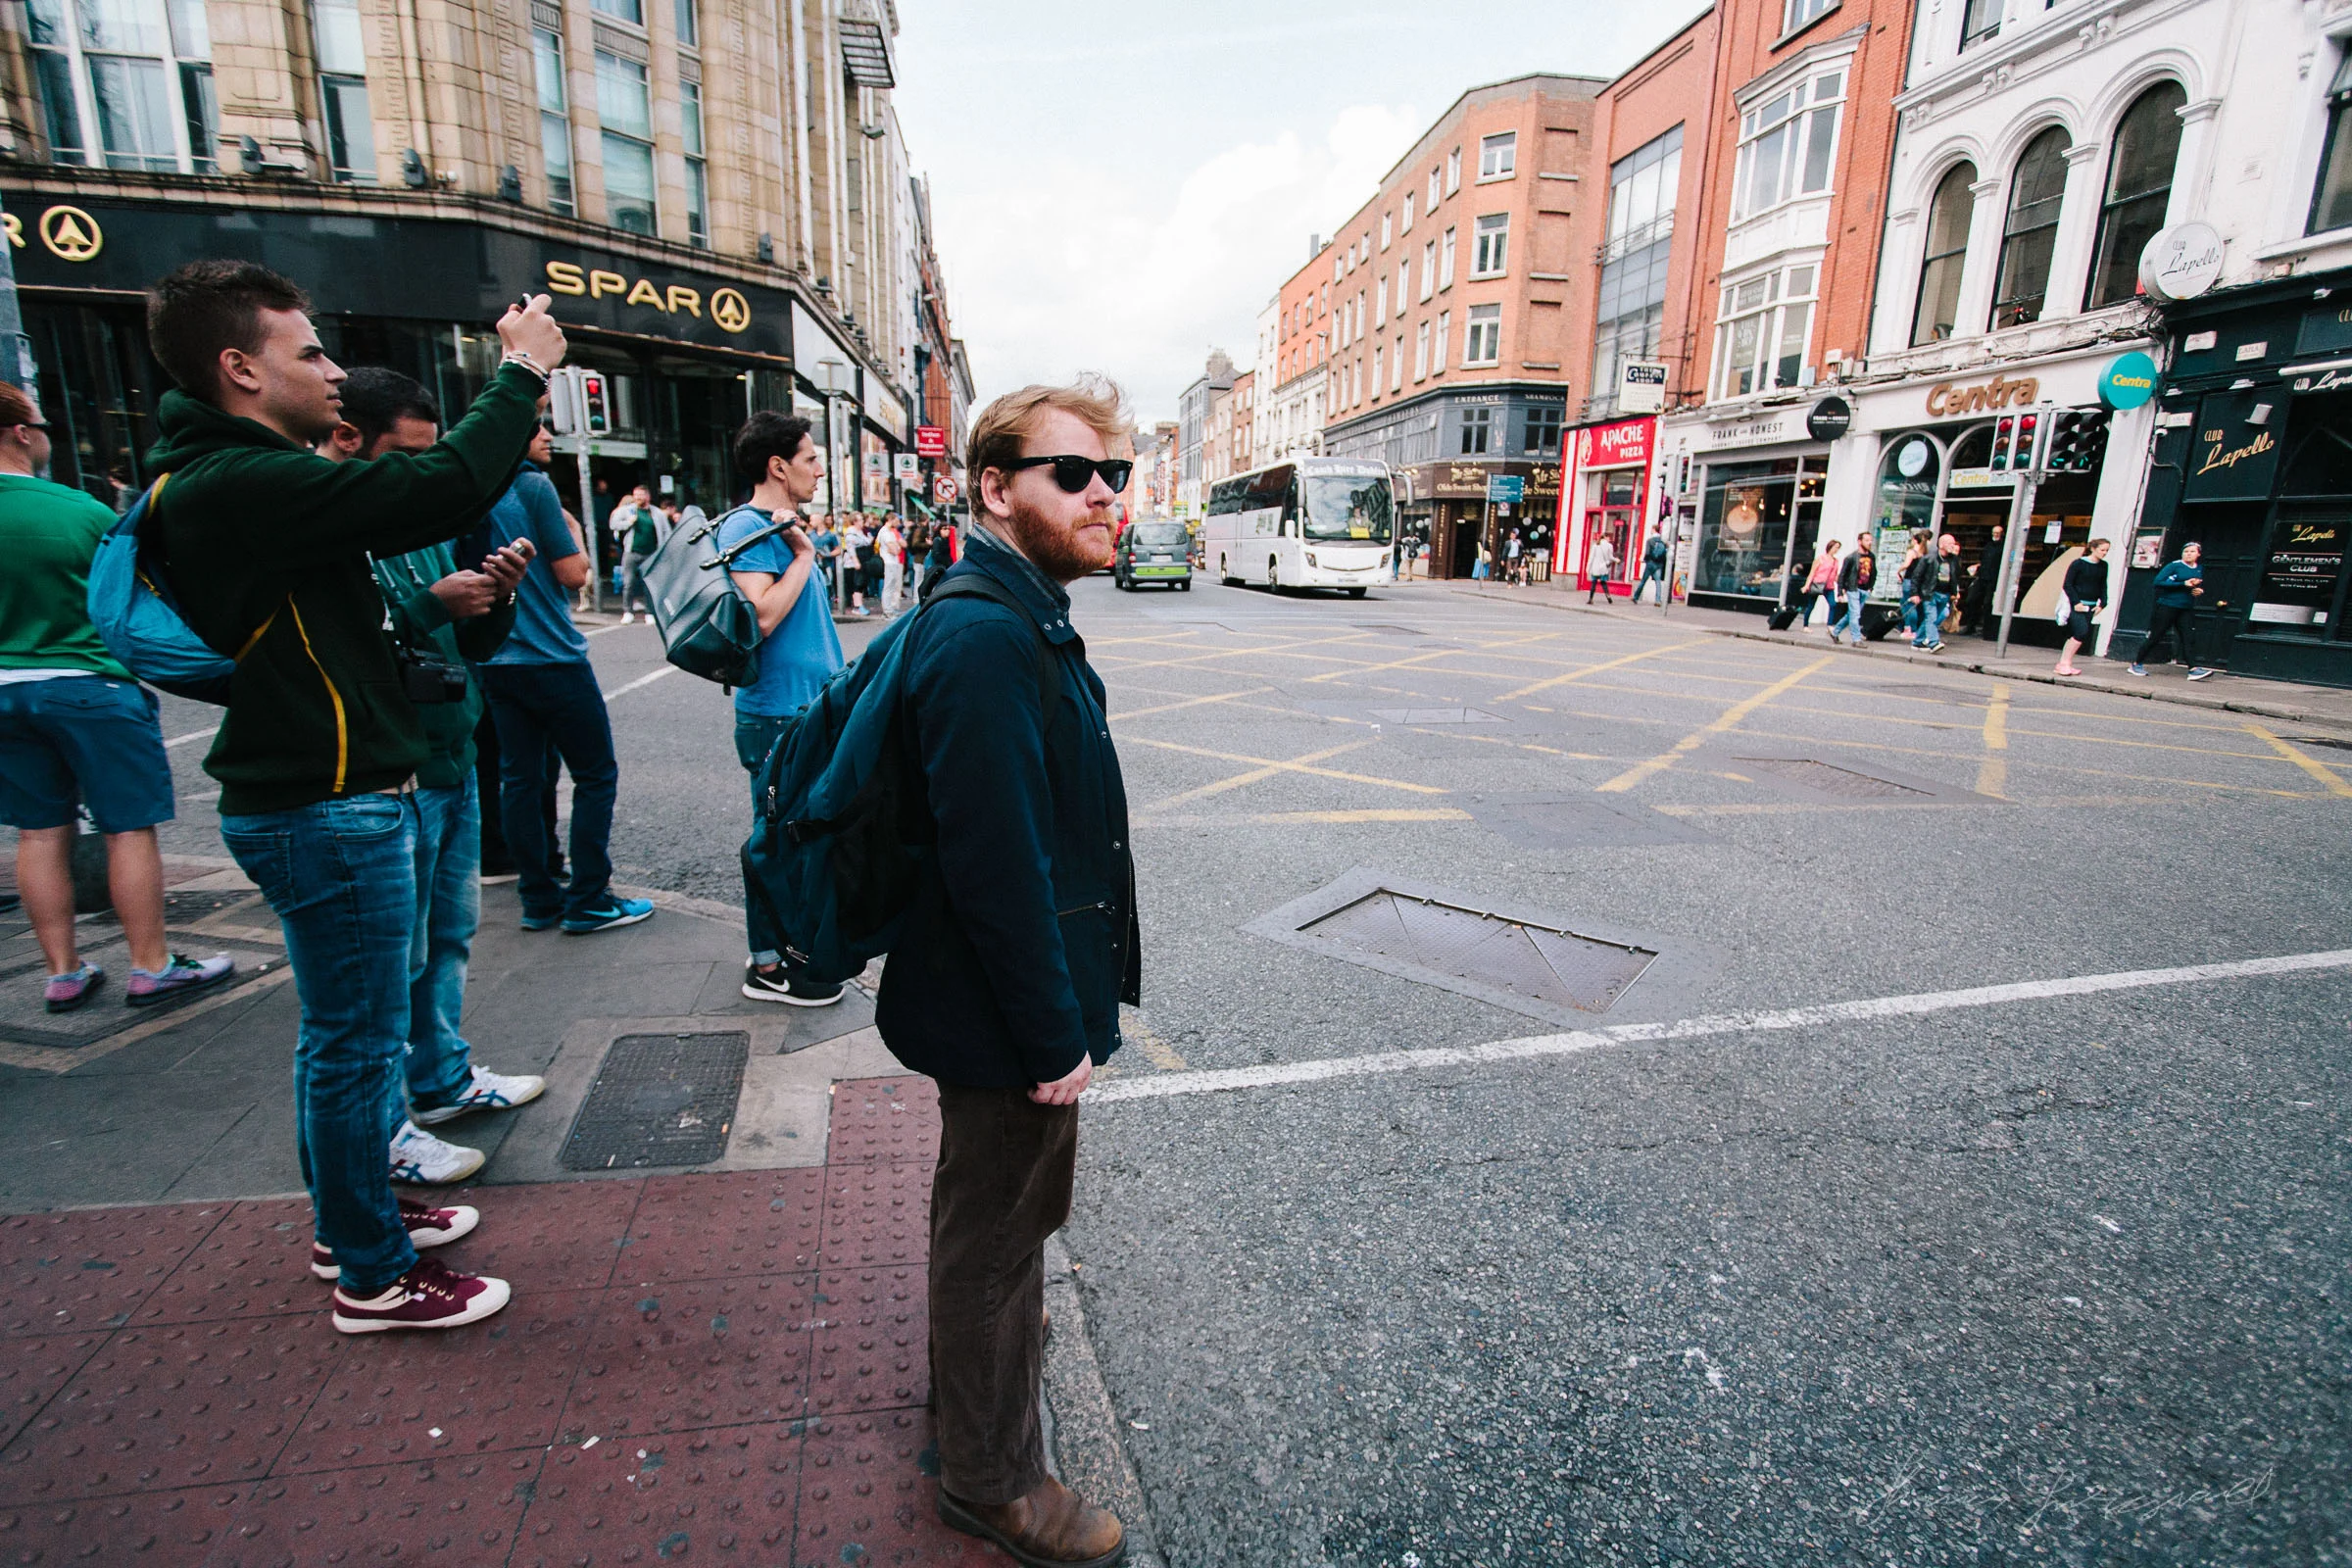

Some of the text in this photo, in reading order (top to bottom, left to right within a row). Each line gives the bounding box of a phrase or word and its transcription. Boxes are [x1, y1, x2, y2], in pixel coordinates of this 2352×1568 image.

[2161, 247, 2220, 276] Lapello
[546, 261, 703, 318] SPAR
[2112, 373, 2151, 389] Centra
[1454, 394, 1500, 404] ENTRANCE
[1925, 374, 2040, 417] Centra
[1600, 424, 1644, 453] APACHE
[1712, 428, 1739, 440] FRANK
[1750, 422, 1784, 435] HONEST
[2204, 429, 2224, 442] CLUB
[1620, 446, 1644, 458] PIZZA
[2196, 431, 2275, 475] Lapello
[1954, 472, 1989, 485] Centra
[2272, 555, 2342, 565] GENTLEMEN'S
[2289, 564, 2318, 573] CLUB
